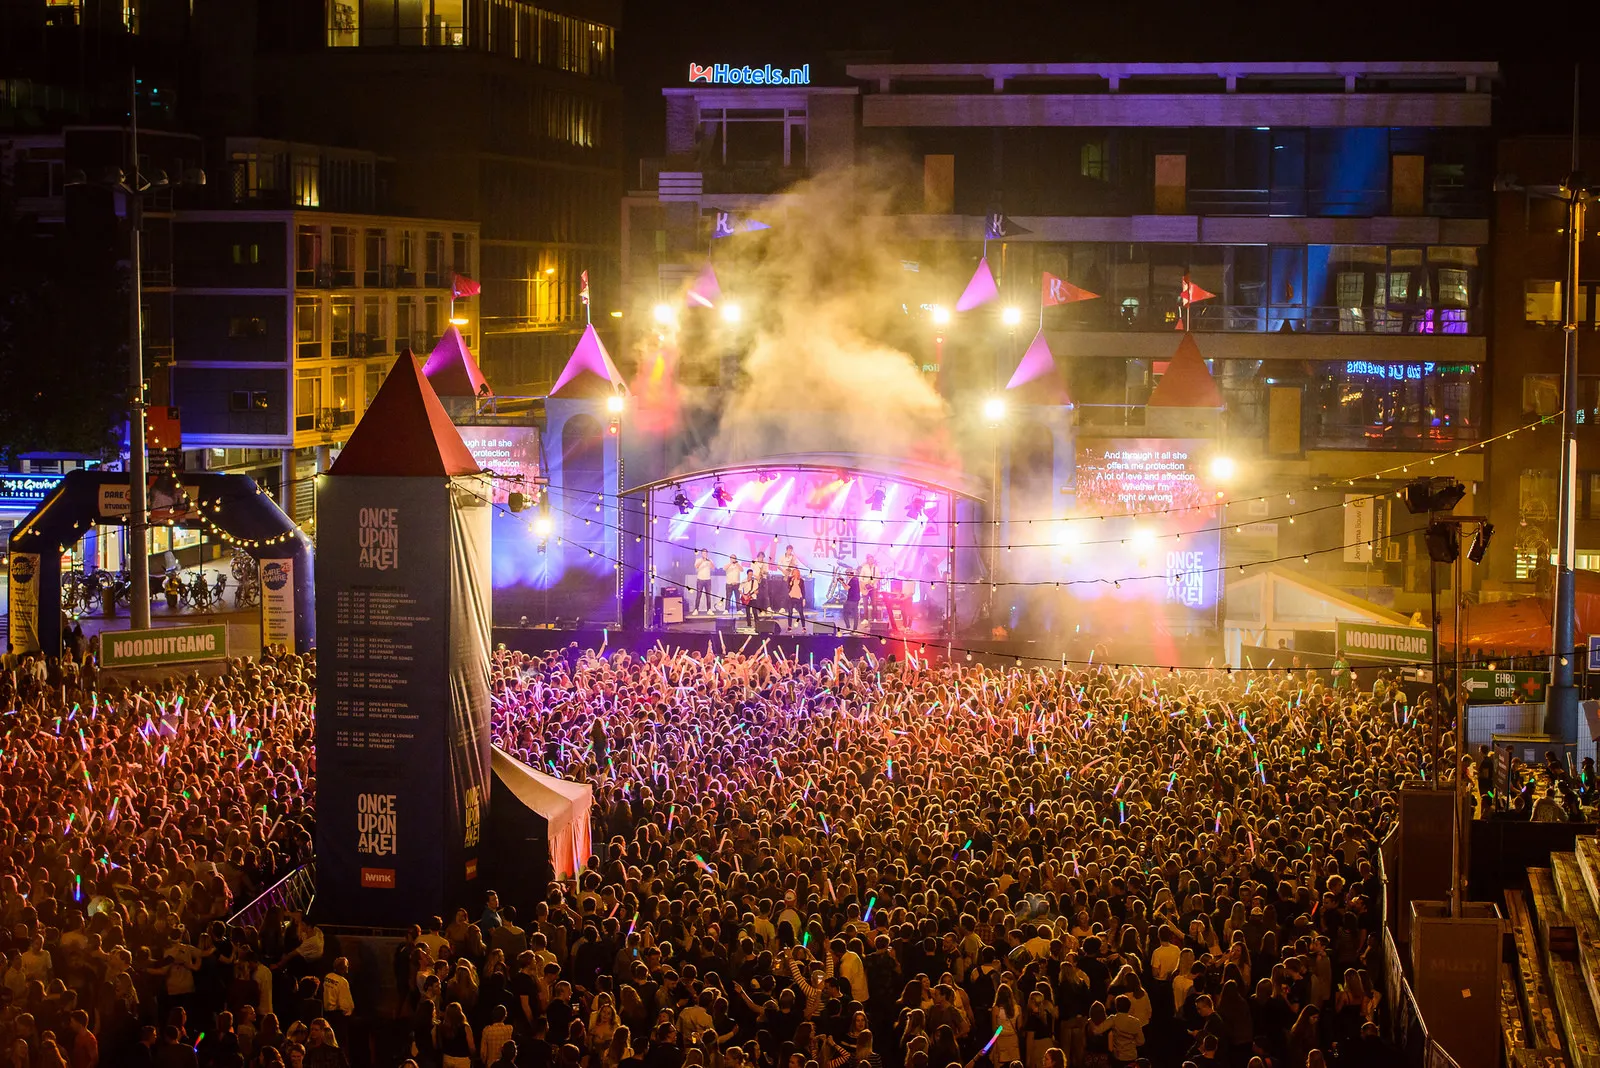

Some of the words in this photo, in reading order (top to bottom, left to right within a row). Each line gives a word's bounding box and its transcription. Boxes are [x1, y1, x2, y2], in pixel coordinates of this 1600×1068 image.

[714, 64, 810, 84] Hotels.nl
[473, 450, 510, 458] protection
[1122, 452, 1152, 461] through
[1146, 462, 1184, 472] protection
[1162, 473, 1195, 481] affection
[1118, 493, 1136, 502] right
[359, 508, 398, 528] ONCE
[359, 528, 398, 548] UPON
[1166, 551, 1203, 569] ONCE
[1166, 569, 1203, 586] UPON
[114, 634, 216, 658] NOODUITGANG
[1346, 630, 1427, 654] NOODUITGANG
[1495, 673, 1515, 683] EHBO
[358, 794, 396, 814] ONCE
[358, 814, 396, 834] UPON
